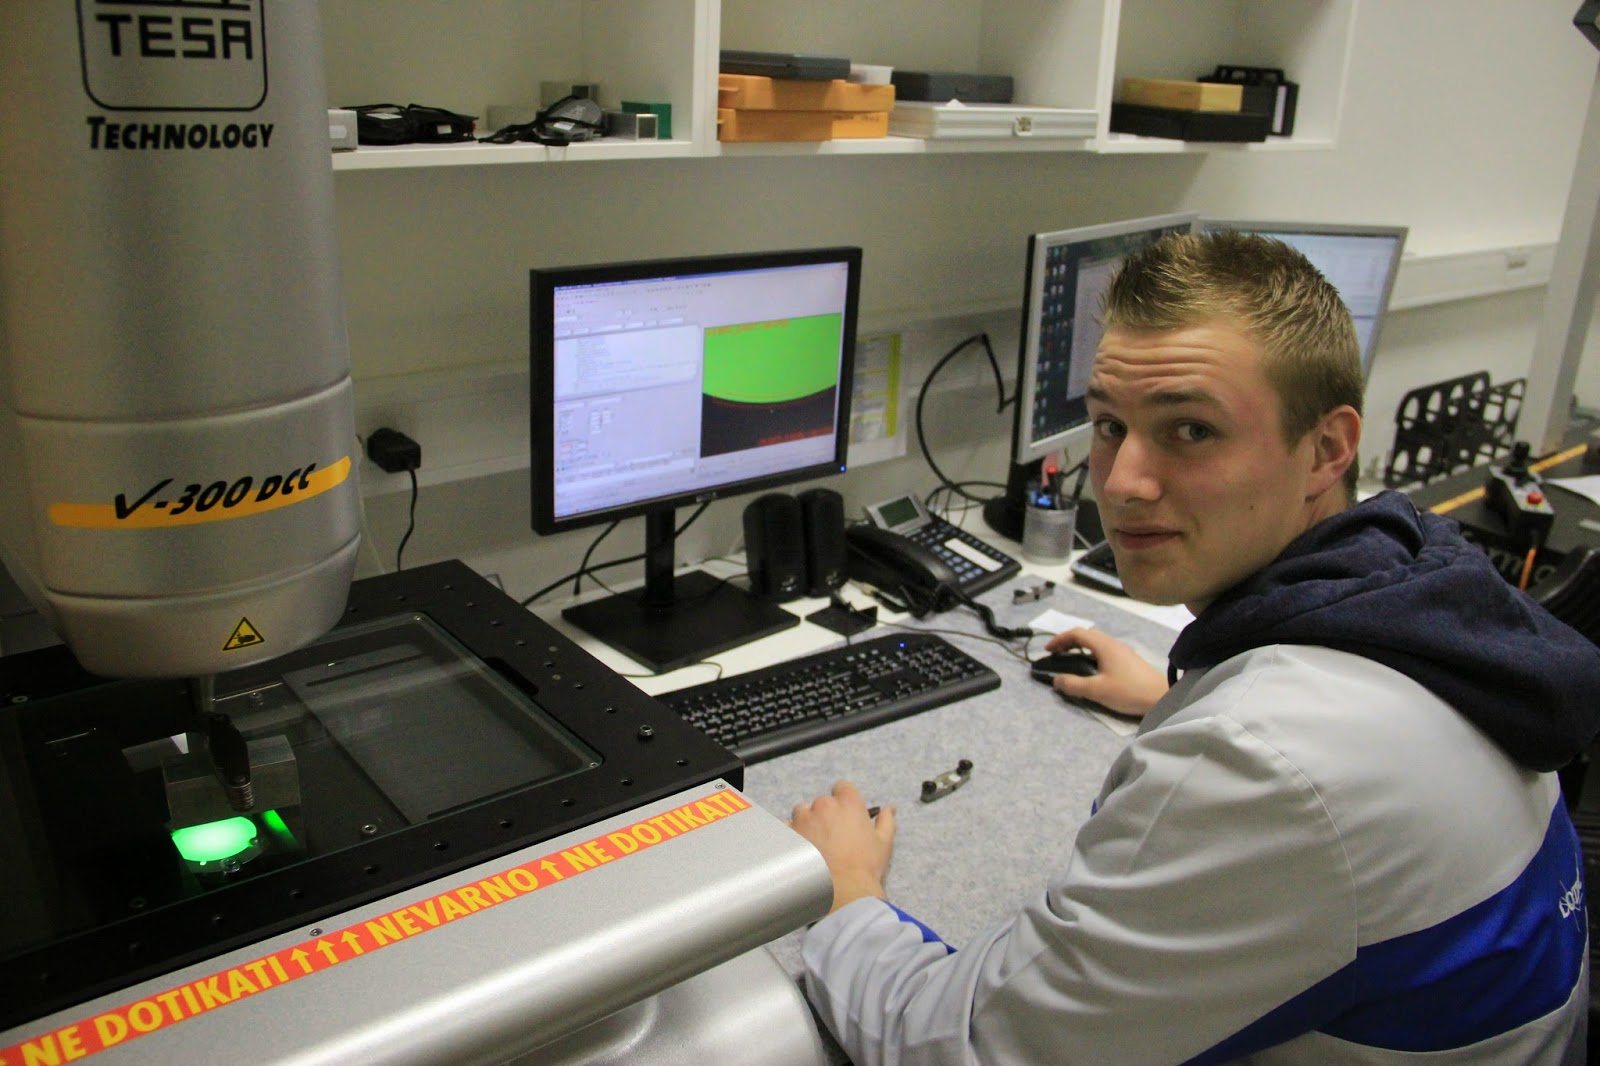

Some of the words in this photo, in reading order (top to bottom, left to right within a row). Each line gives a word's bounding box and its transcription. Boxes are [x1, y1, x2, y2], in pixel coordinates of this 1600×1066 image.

[93, 12, 254, 61] TESA
[86, 115, 275, 151] TECHNOLOGY
[114, 476, 254, 520] V-300
[255, 462, 318, 503] DCC
[23, 1027, 86, 1066] NE
[95, 957, 288, 1047] DOTIKATI
[366, 866, 539, 946] NEVARNO
[561, 841, 613, 872] NE
[607, 791, 746, 854] DOTIKATI
